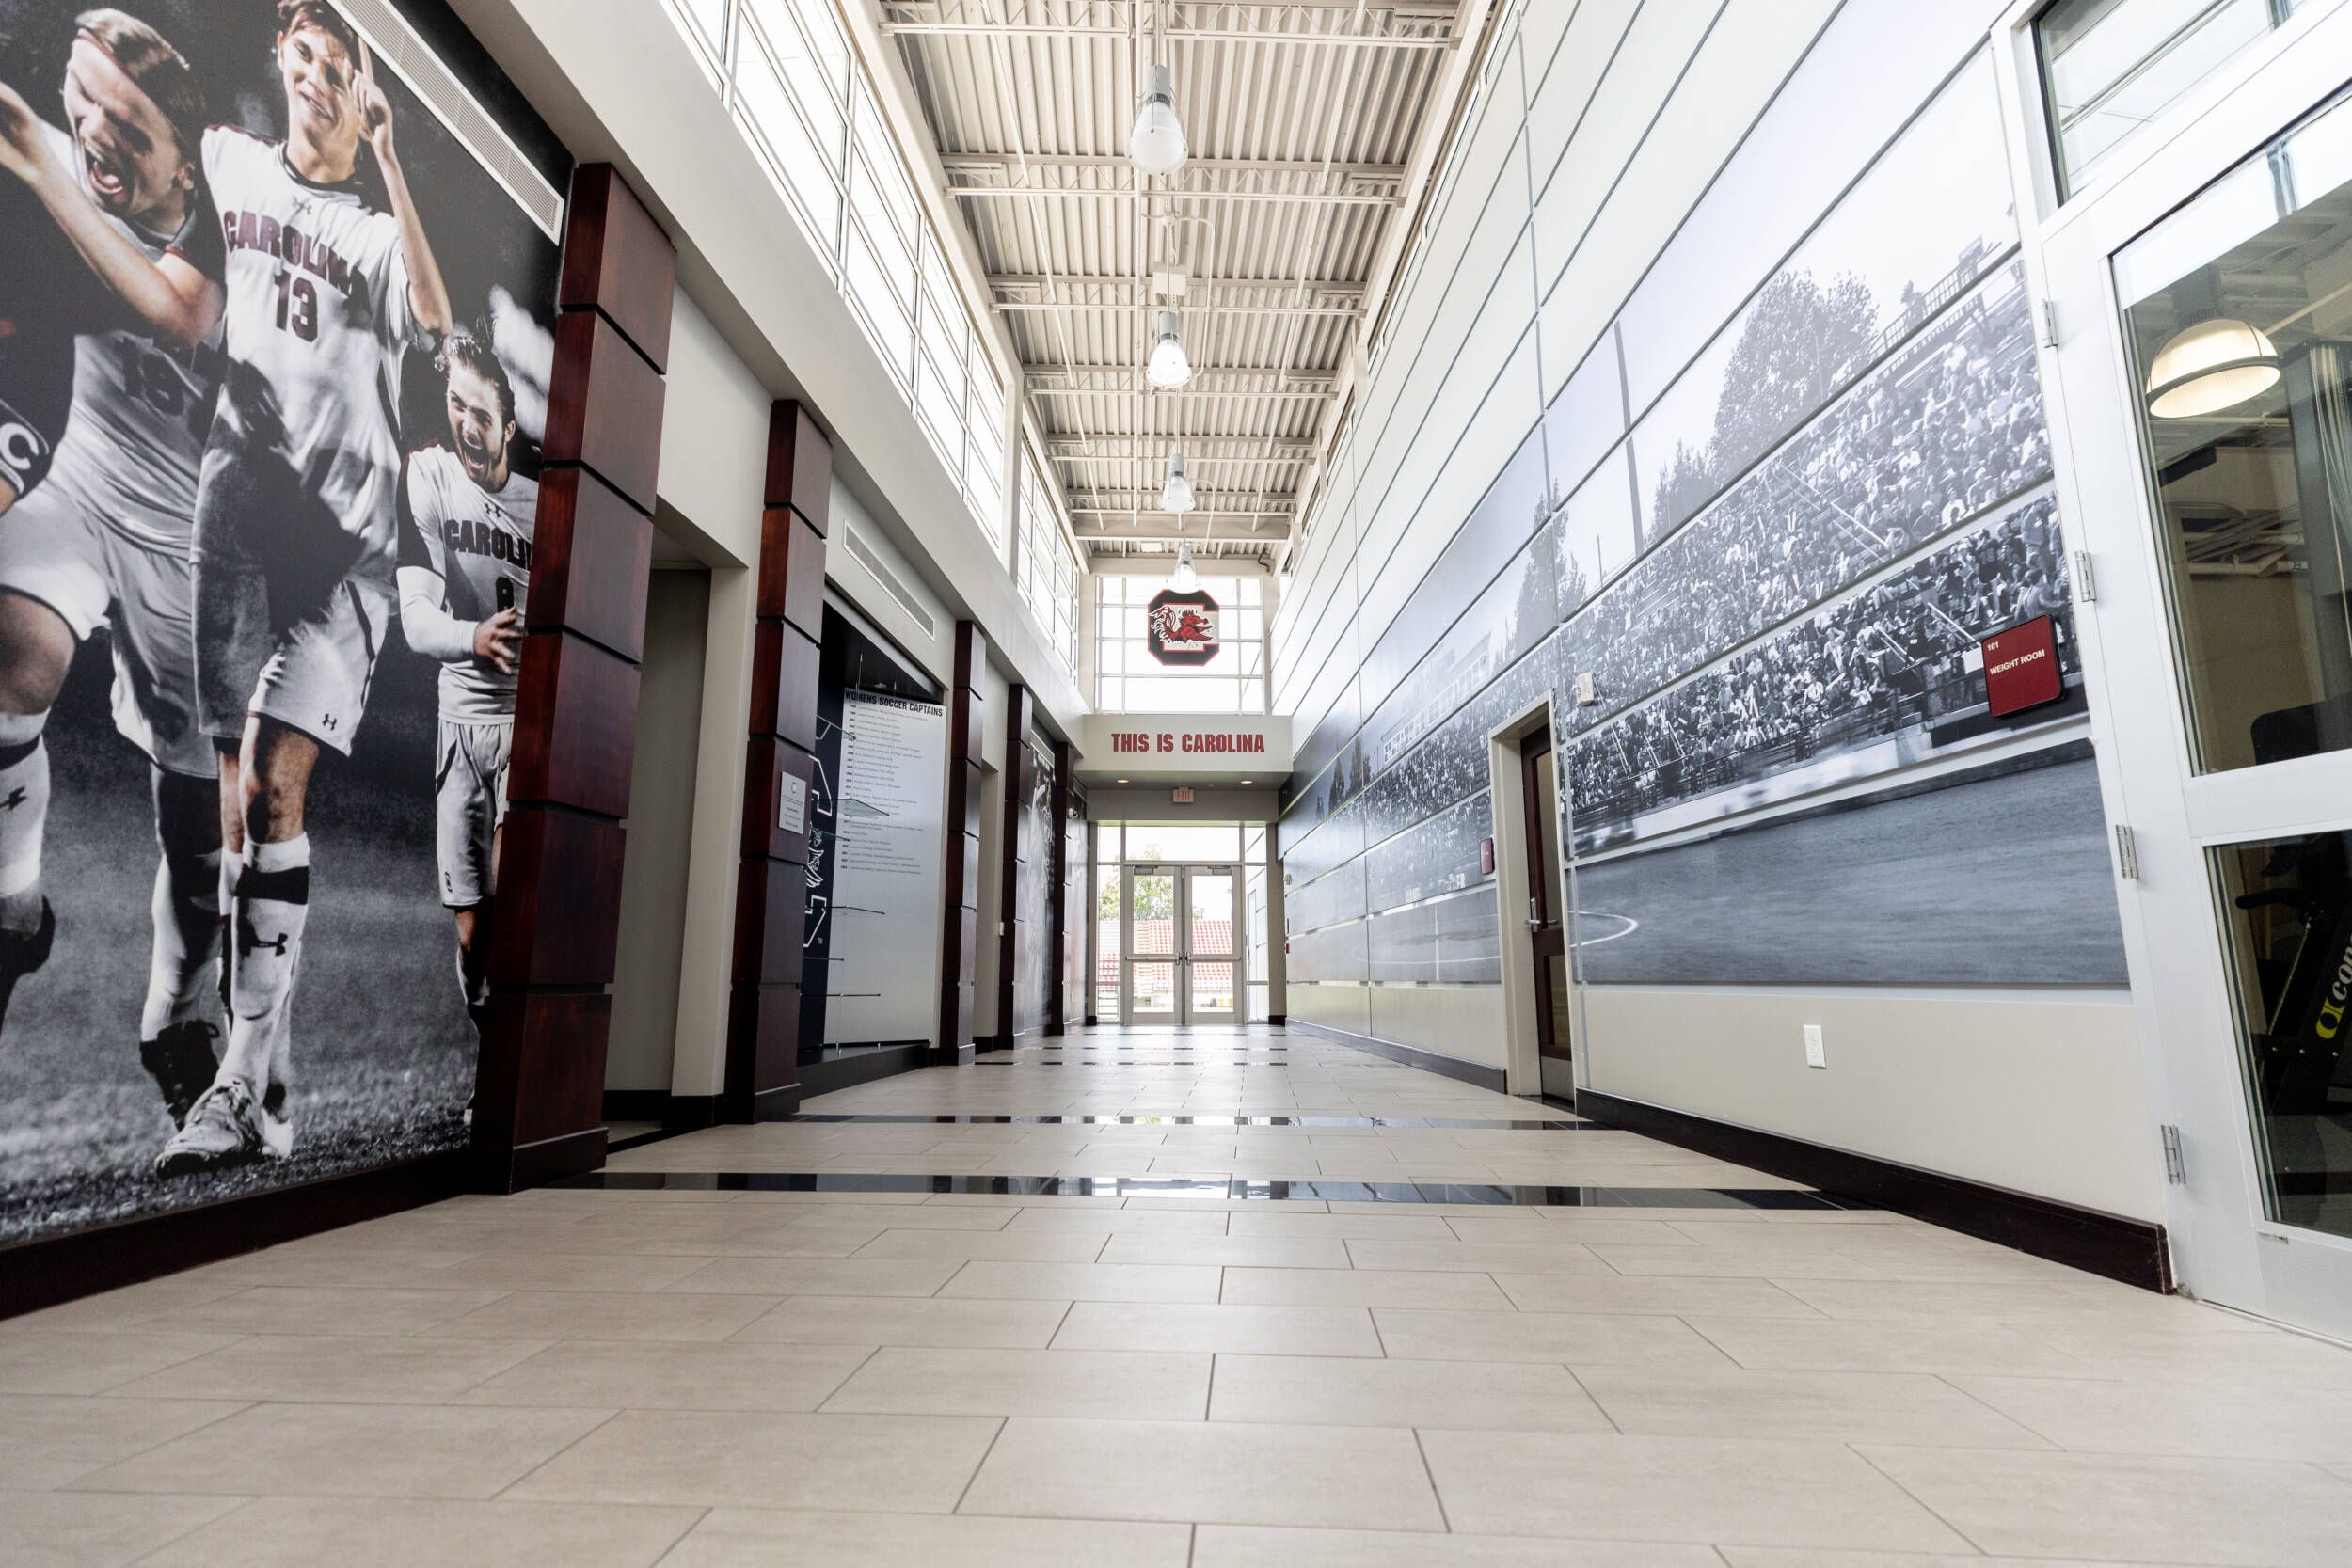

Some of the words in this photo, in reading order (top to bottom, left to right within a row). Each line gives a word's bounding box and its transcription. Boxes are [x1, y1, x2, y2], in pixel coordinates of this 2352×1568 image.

[275, 268, 318, 342] 13
[1987, 641, 1999, 651] 101
[1990, 658, 2019, 675] WEIGHT
[2020, 649, 2045, 664] ROOM
[845, 689, 877, 705] WOMENS
[879, 697, 908, 711] SOCCER
[909, 703, 943, 717] CAPTAINS
[1111, 733, 1150, 752] THIS
[1157, 733, 1174, 752] IS
[1182, 734, 1265, 752] CAROLINA
[1176, 789, 1192, 801] EXIT
